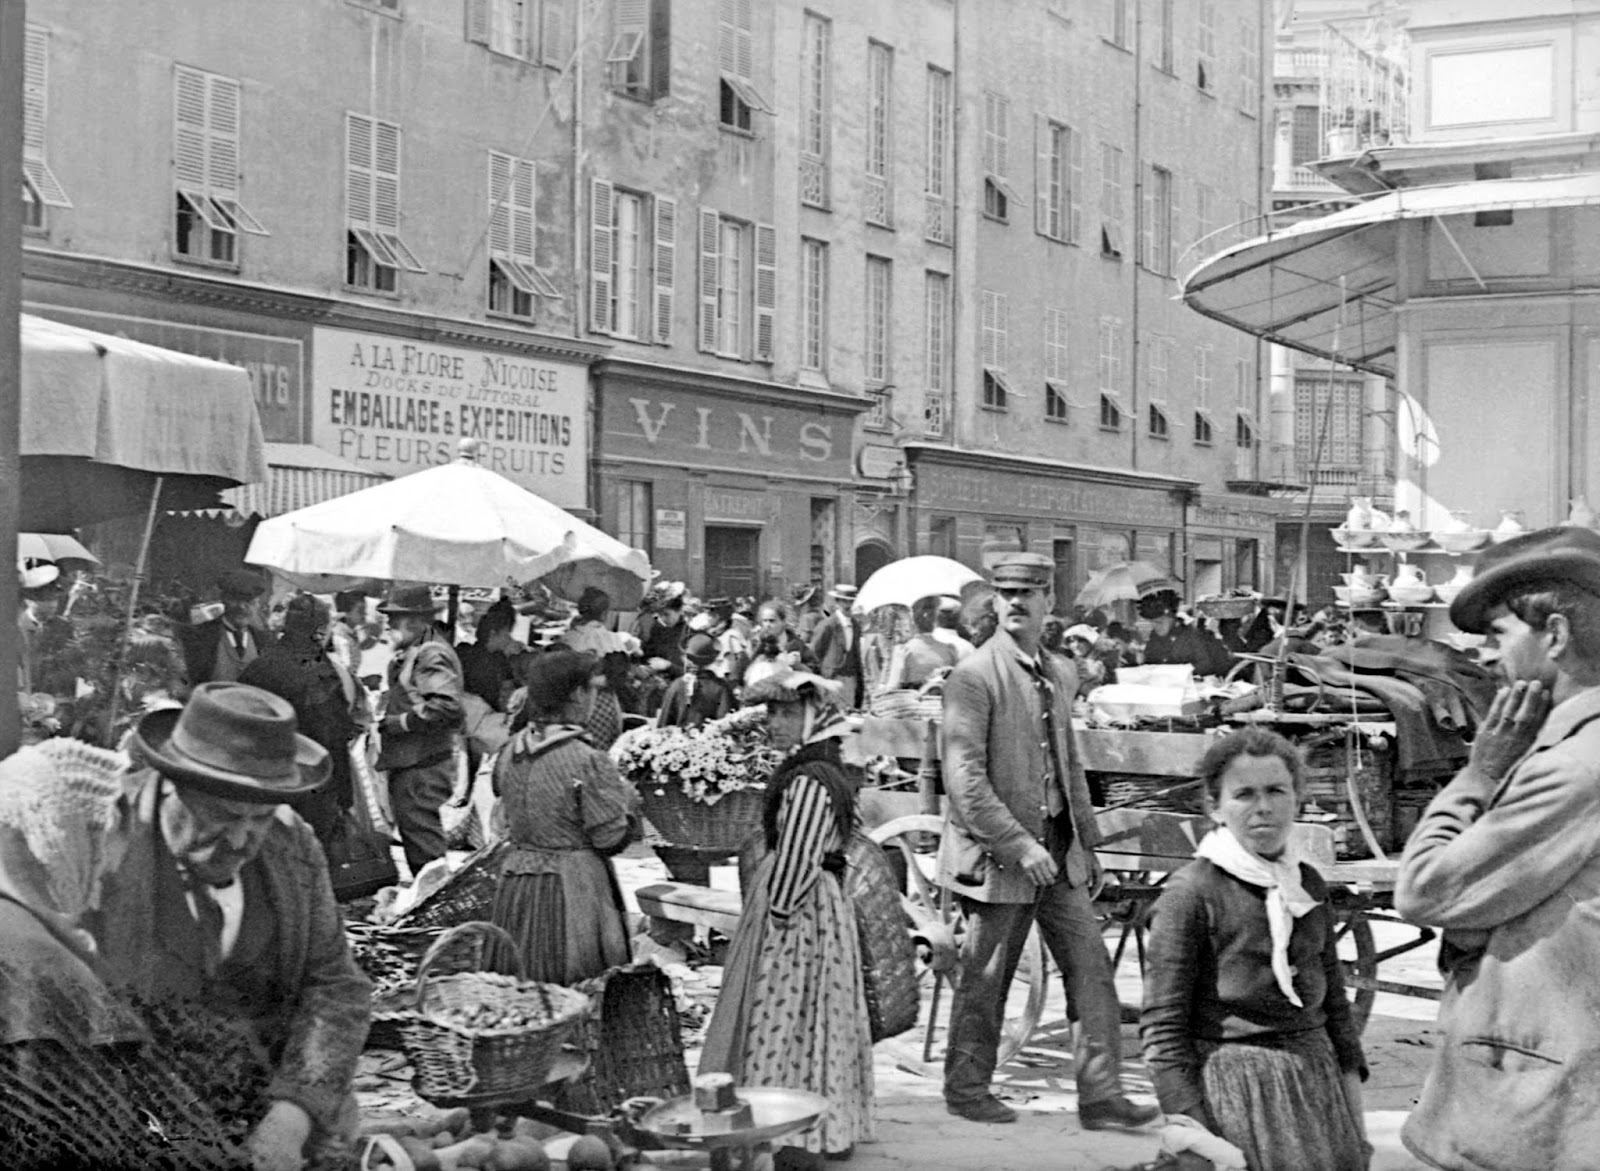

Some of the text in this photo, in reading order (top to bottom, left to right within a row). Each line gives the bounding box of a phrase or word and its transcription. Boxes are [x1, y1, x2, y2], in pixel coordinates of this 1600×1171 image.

[350, 343, 365, 367] A
[371, 345, 396, 371] LA
[400, 345, 465, 380] FLORE
[365, 370, 541, 408] DOCKS DU LITTORAL
[331, 388, 572, 447] EMBALLAGE & EXPEDITIONS
[630, 399, 833, 462] VINS
[338, 428, 567, 476] FLEURS FRUITS
